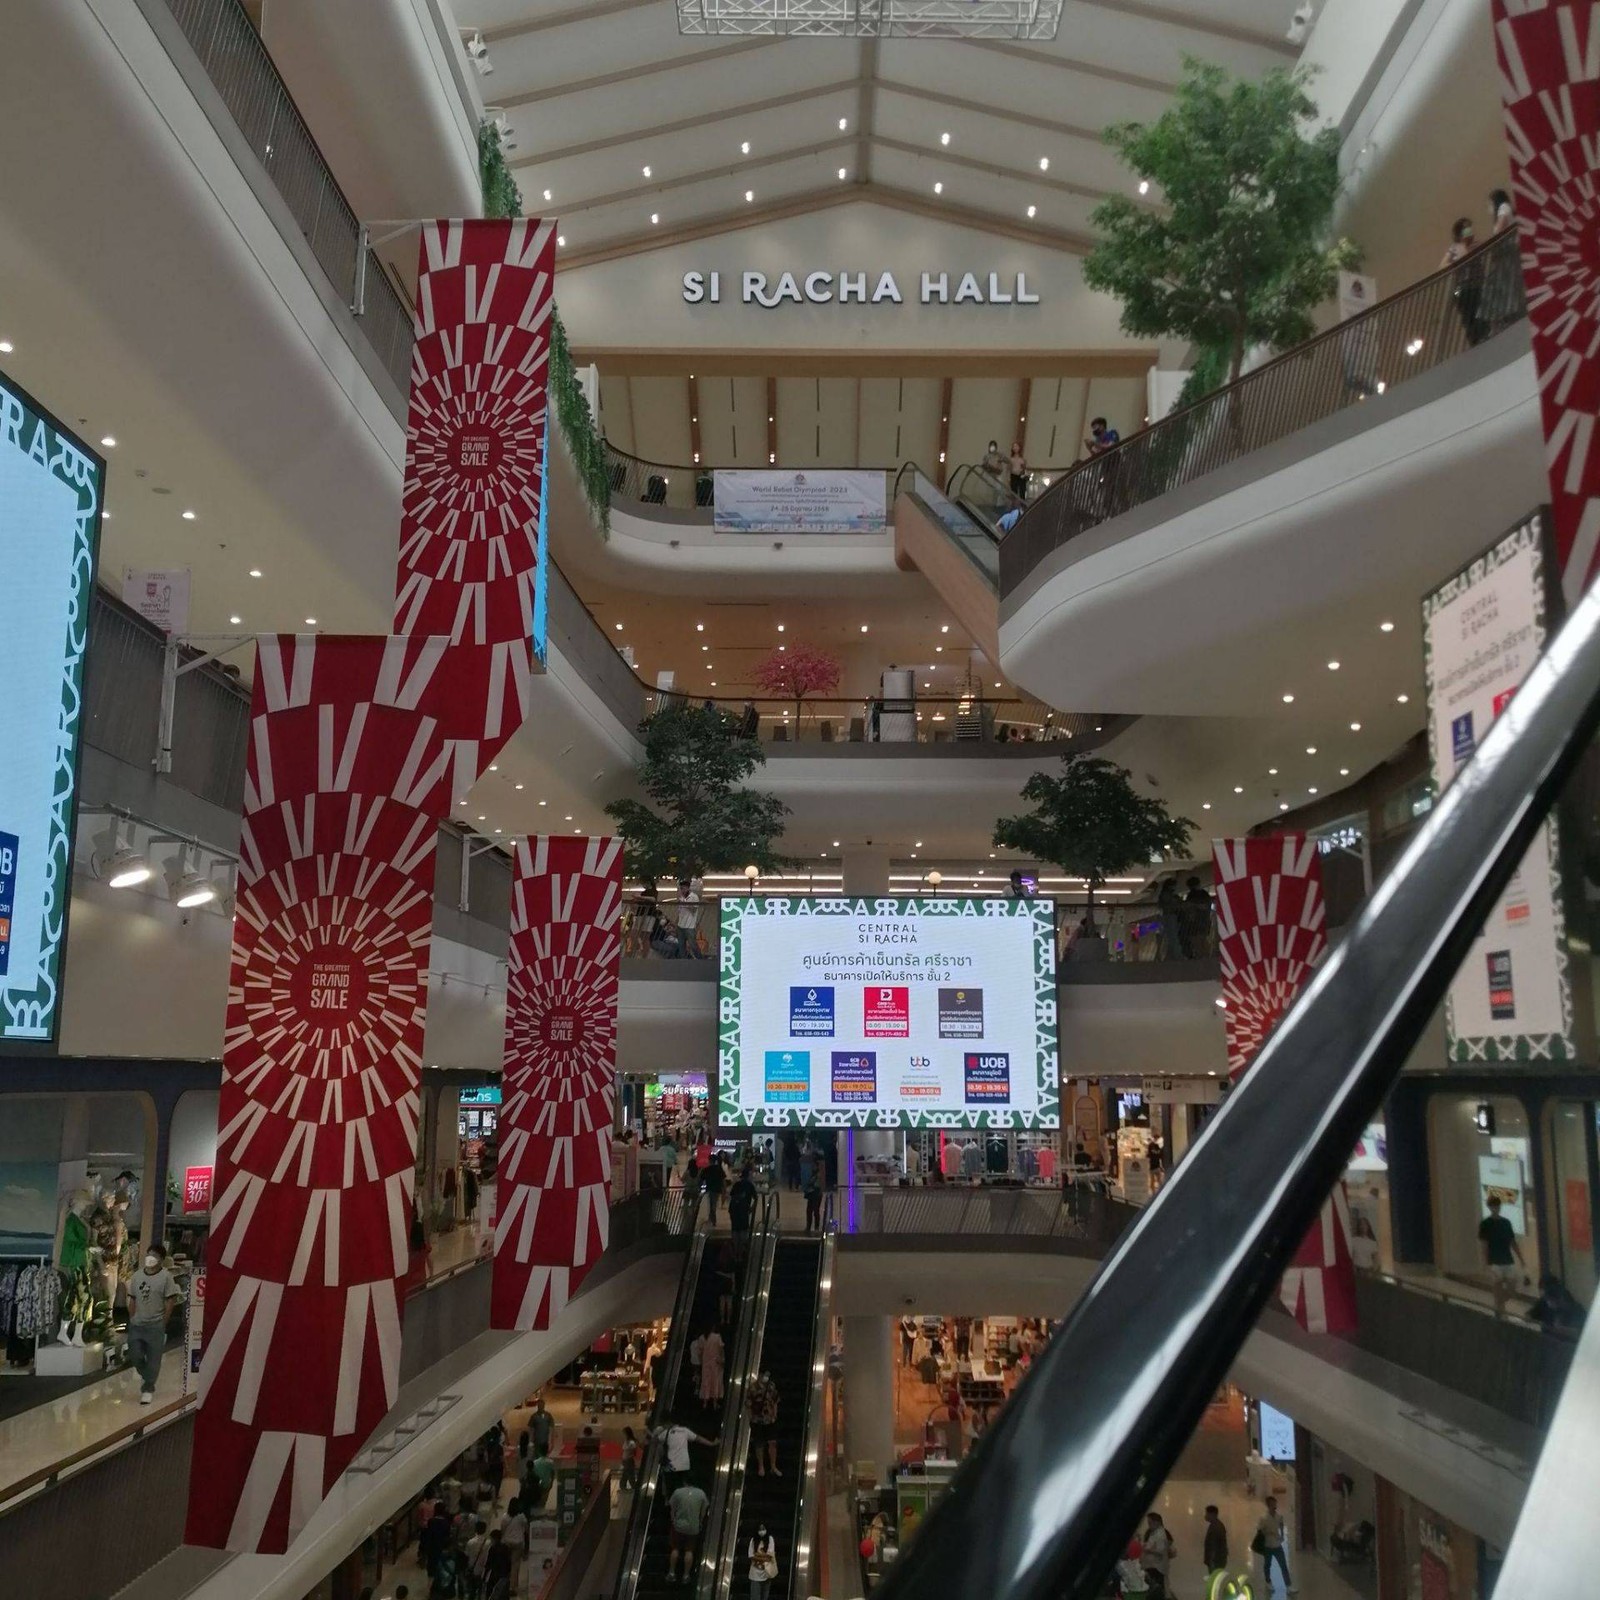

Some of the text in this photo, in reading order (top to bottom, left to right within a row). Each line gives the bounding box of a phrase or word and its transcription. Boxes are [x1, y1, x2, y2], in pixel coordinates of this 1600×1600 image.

[683, 271, 1040, 307] SI RACHA HALL
[461, 442, 490, 452] GRAND
[461, 452, 489, 466] SALE
[858, 924, 918, 933] CENTRAL
[858, 934, 918, 945] SI RACHA
[803, 952, 972, 969] ศูนย์การค้าเซ็นทรัล ศรีราชา
[324, 964, 350, 972] GREATEST
[312, 973, 350, 987] GRAND
[824, 969, 951, 982] ธนาคารเปิดให้บริการ ชั้น 2
[310, 988, 349, 1009] SALE
[551, 1021, 574, 1029] GRAND
[550, 1029, 573, 1041] SALE
[910, 1056, 930, 1067] ttb
[980, 1057, 1006, 1068] UOB
[187, 1180, 209, 1191] SALE
